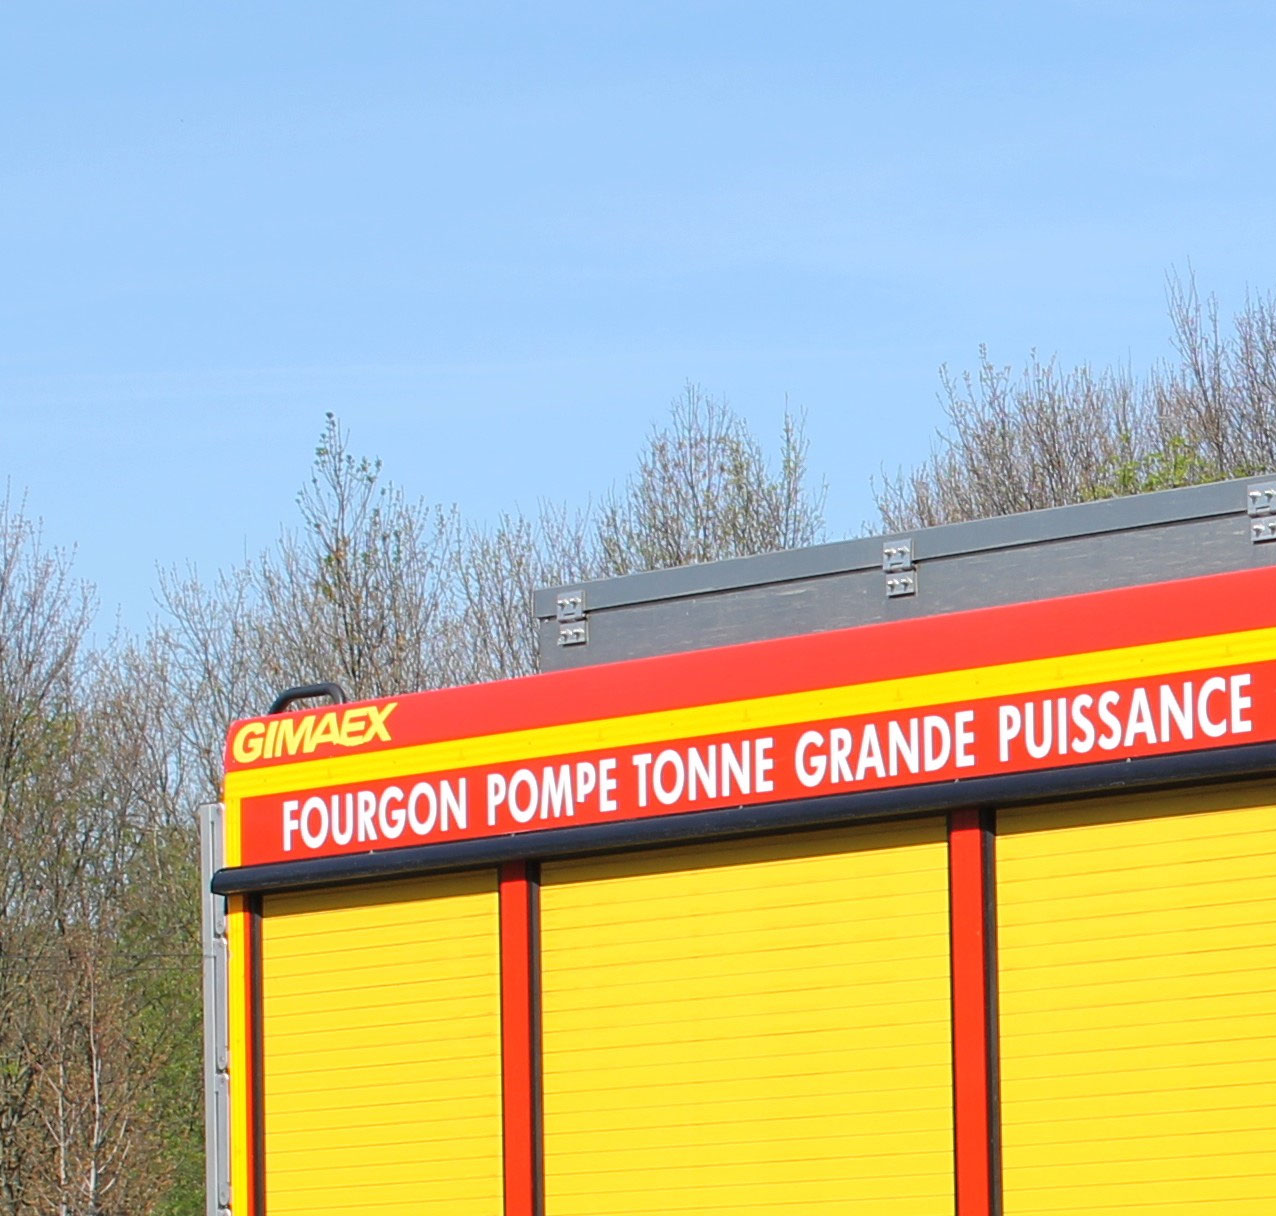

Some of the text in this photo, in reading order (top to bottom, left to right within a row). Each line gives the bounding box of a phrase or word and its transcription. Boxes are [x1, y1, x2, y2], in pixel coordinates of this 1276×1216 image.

[233, 702, 398, 764] GIMAEX
[282, 673, 1252, 851] FOURGON POMPE TONNE GRANDE PUISSANCE
